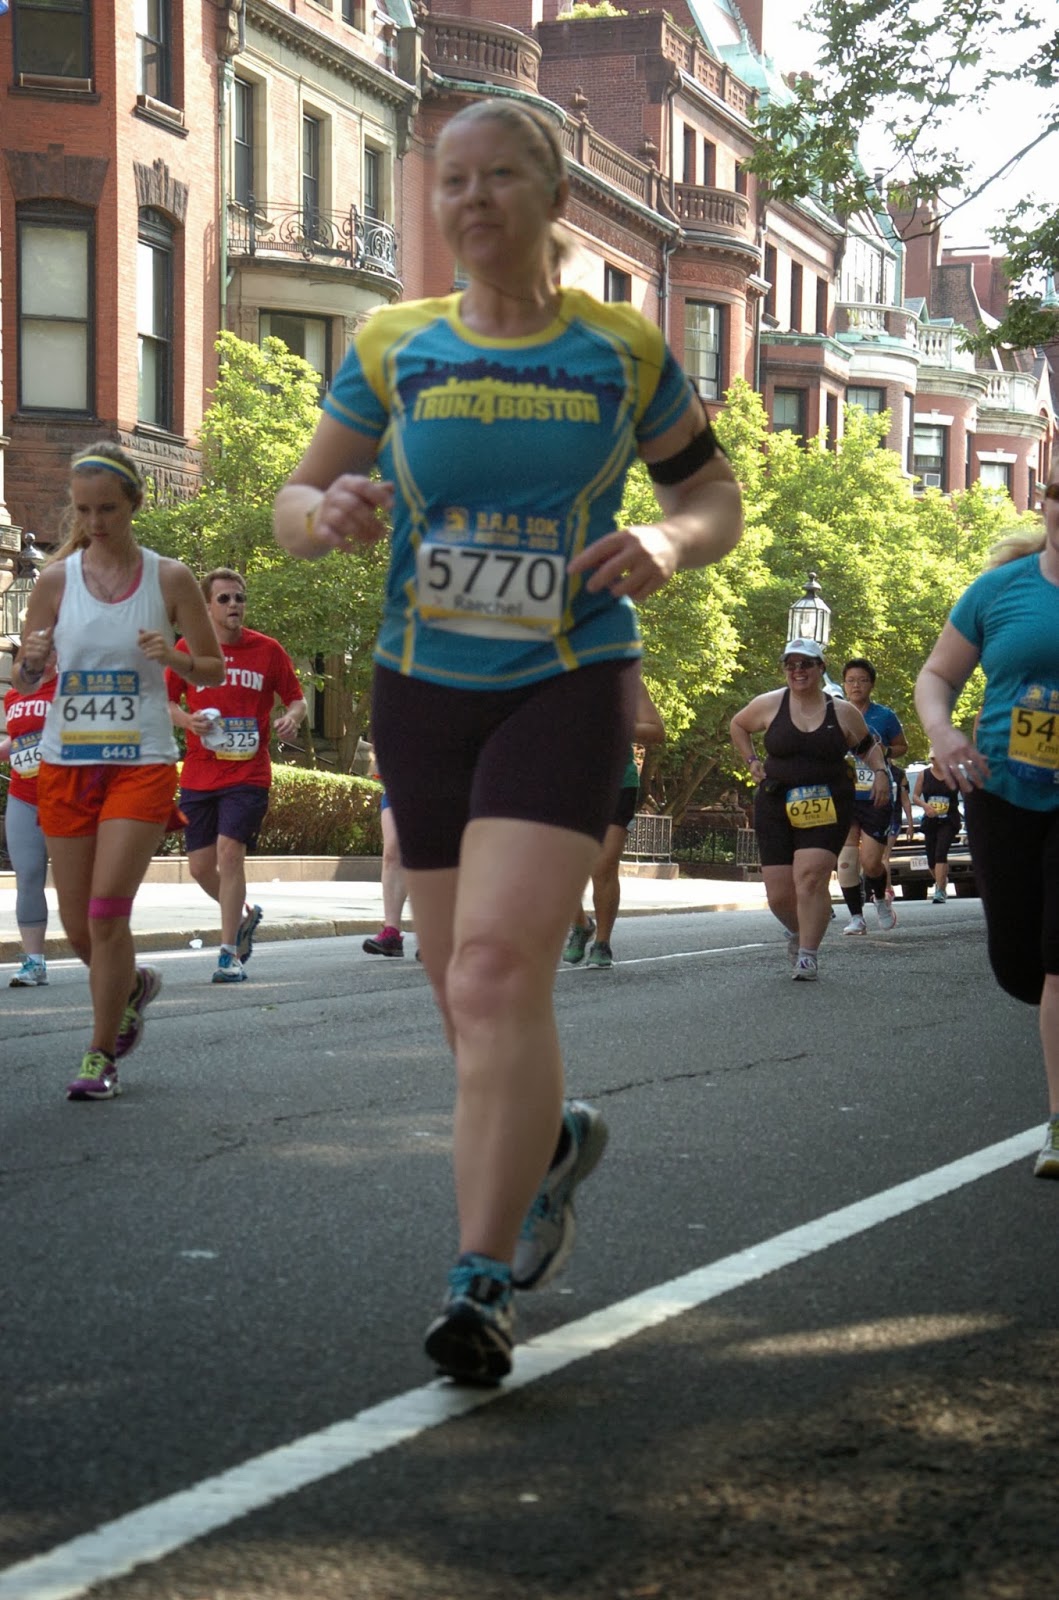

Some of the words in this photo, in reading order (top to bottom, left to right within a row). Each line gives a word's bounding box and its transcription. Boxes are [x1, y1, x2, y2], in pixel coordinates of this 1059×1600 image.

[428, 547, 557, 602] 5770
[63, 696, 135, 722] 6443
[1016, 709, 1057, 742] 54
[222, 732, 258, 748] 325
[14, 747, 43, 767] 446
[101, 746, 137, 759] 6443
[790, 798, 830, 816] 6257
